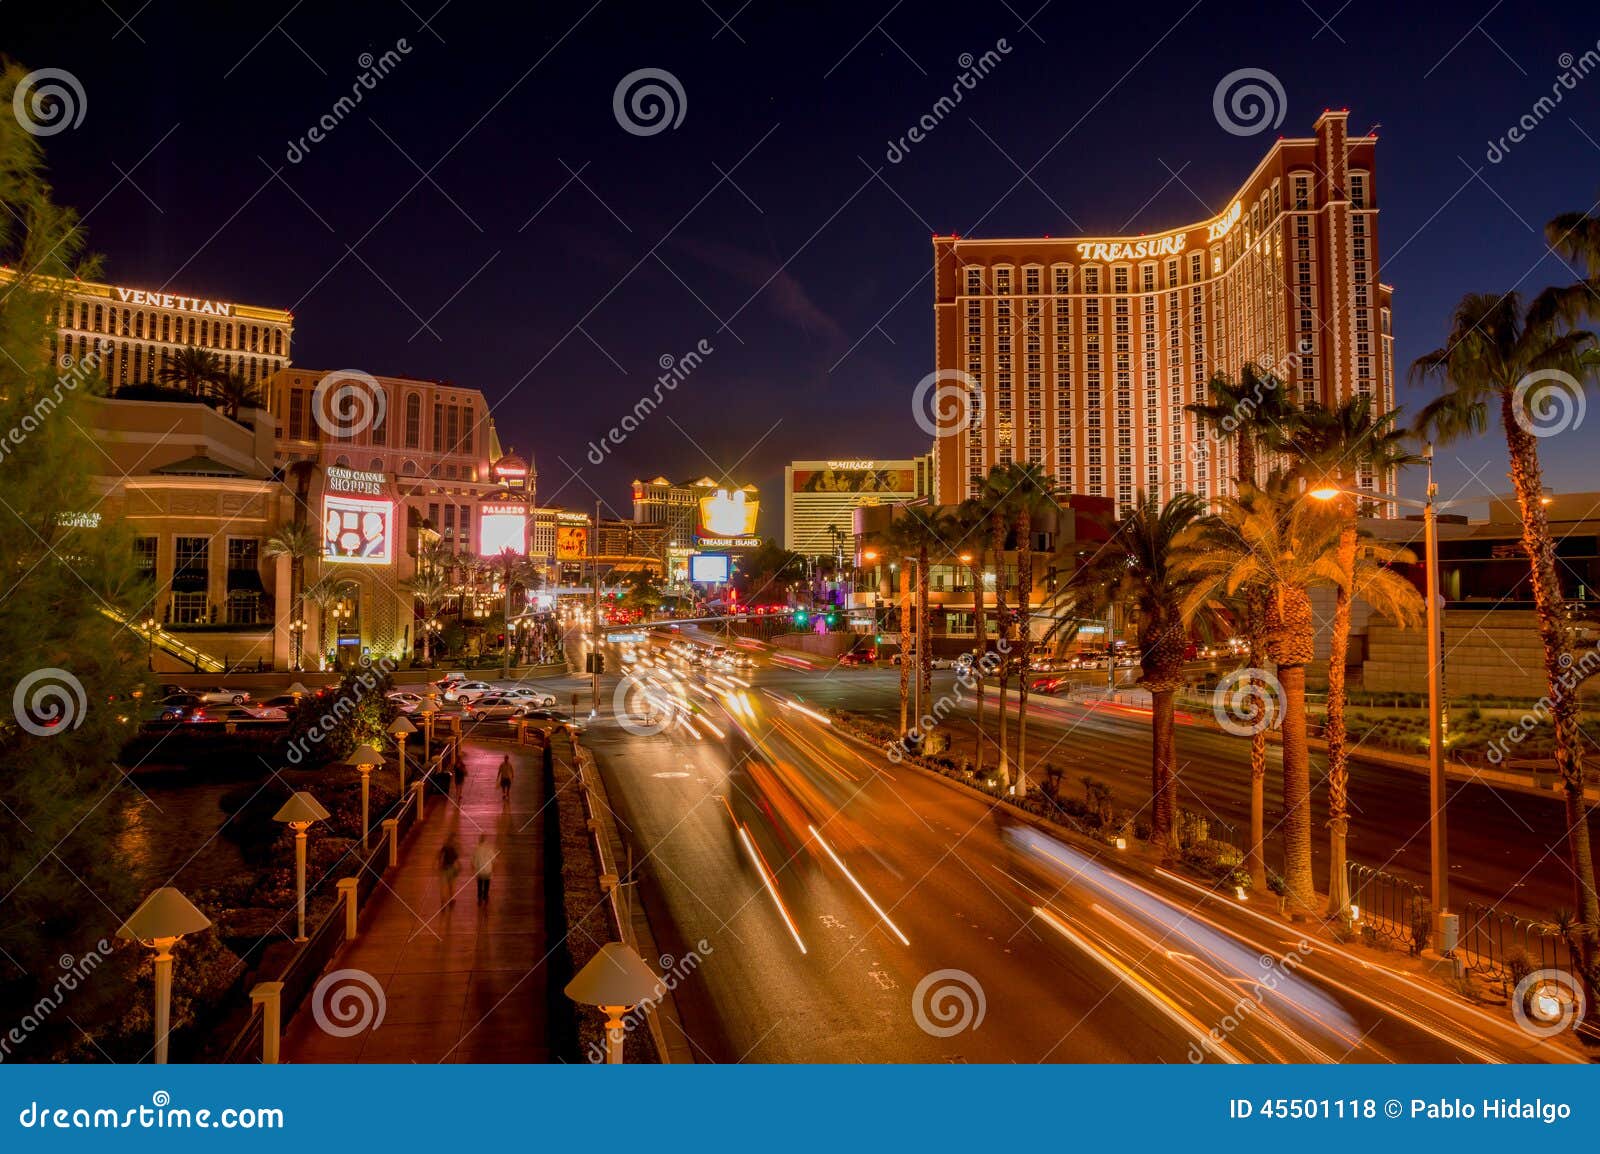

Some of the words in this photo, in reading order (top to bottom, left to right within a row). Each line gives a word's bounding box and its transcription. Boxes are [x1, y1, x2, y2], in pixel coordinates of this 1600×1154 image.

[1077, 233, 1186, 262] TREASURE
[117, 287, 231, 316] VENETIAN
[327, 466, 351, 479] GRAND
[330, 477, 381, 495] SHOPPES
[482, 505, 525, 514] PALAZZO
